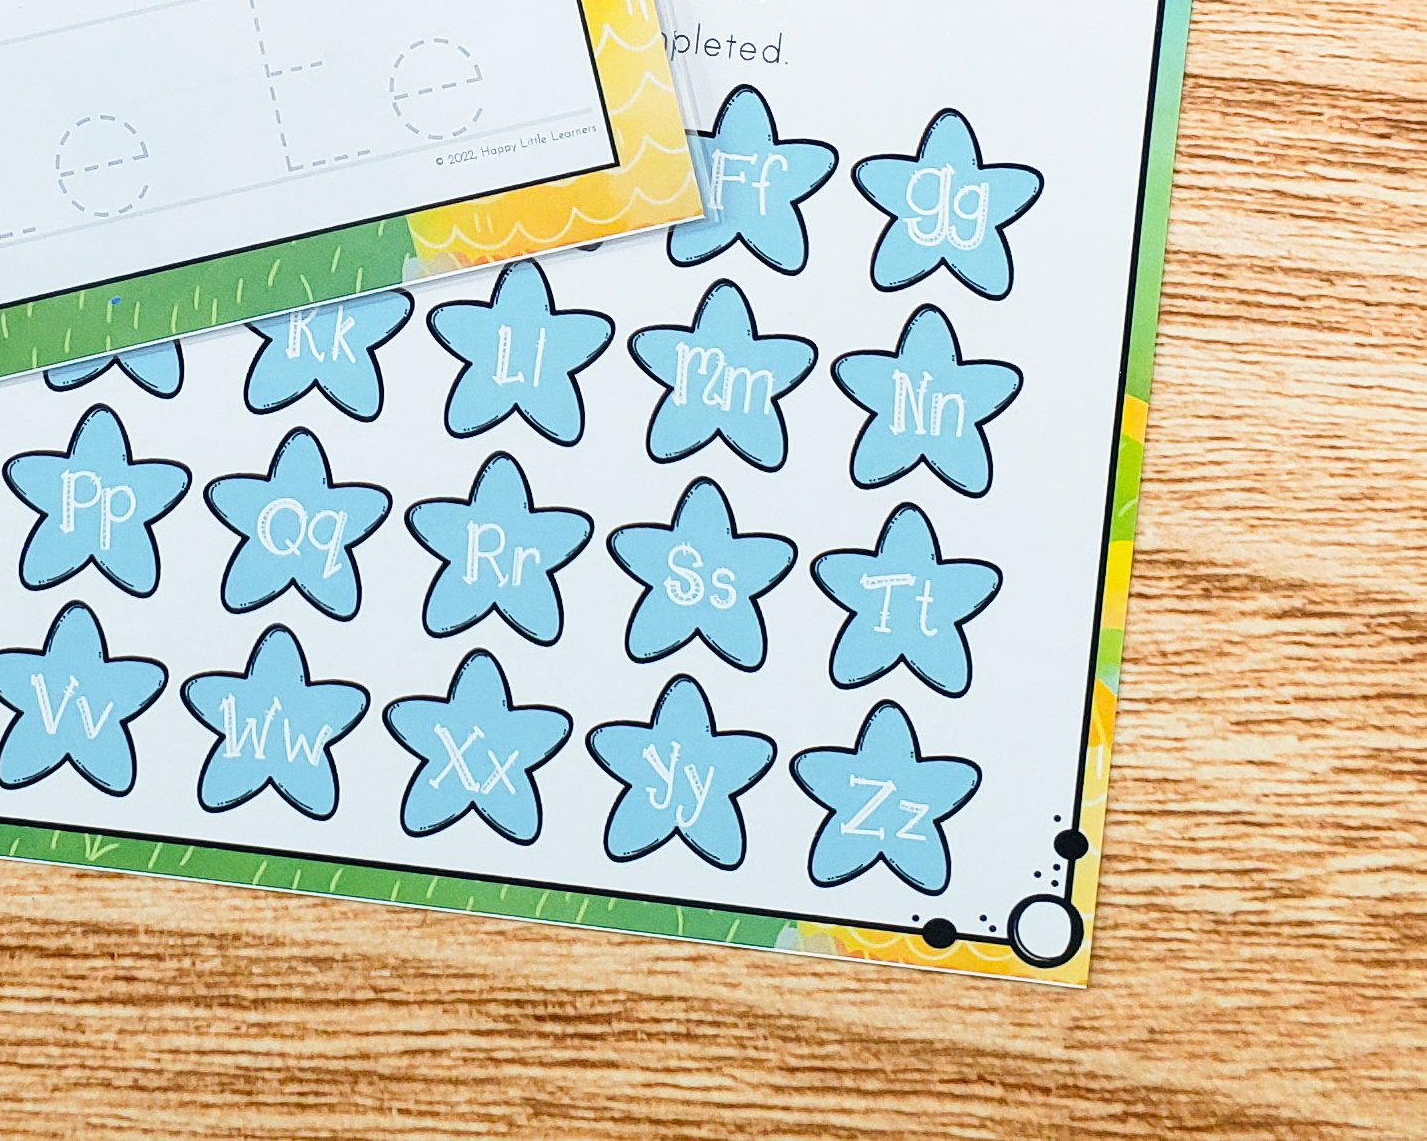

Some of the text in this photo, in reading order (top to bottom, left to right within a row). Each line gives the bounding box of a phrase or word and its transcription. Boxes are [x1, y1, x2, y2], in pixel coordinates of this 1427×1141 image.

[660, 21, 790, 66] pleted.
[481, 144, 517, 158] Happy
[520, 133, 547, 148] Little
[551, 125, 597, 141] Learners
[708, 149, 788, 216] Ff
[285, 305, 965, 438] Kk Ll Mm Nn
[59, 469, 137, 551] Pp
[257, 497, 348, 579] Qq
[462, 520, 541, 587] Rr
[663, 542, 737, 609] Ss
[859, 573, 938, 637] Tt
[30, 673, 114, 739] Vv
[218, 694, 333, 767] Ww
[429, 723, 519, 795] Xx
[840, 774, 930, 841] Zz
